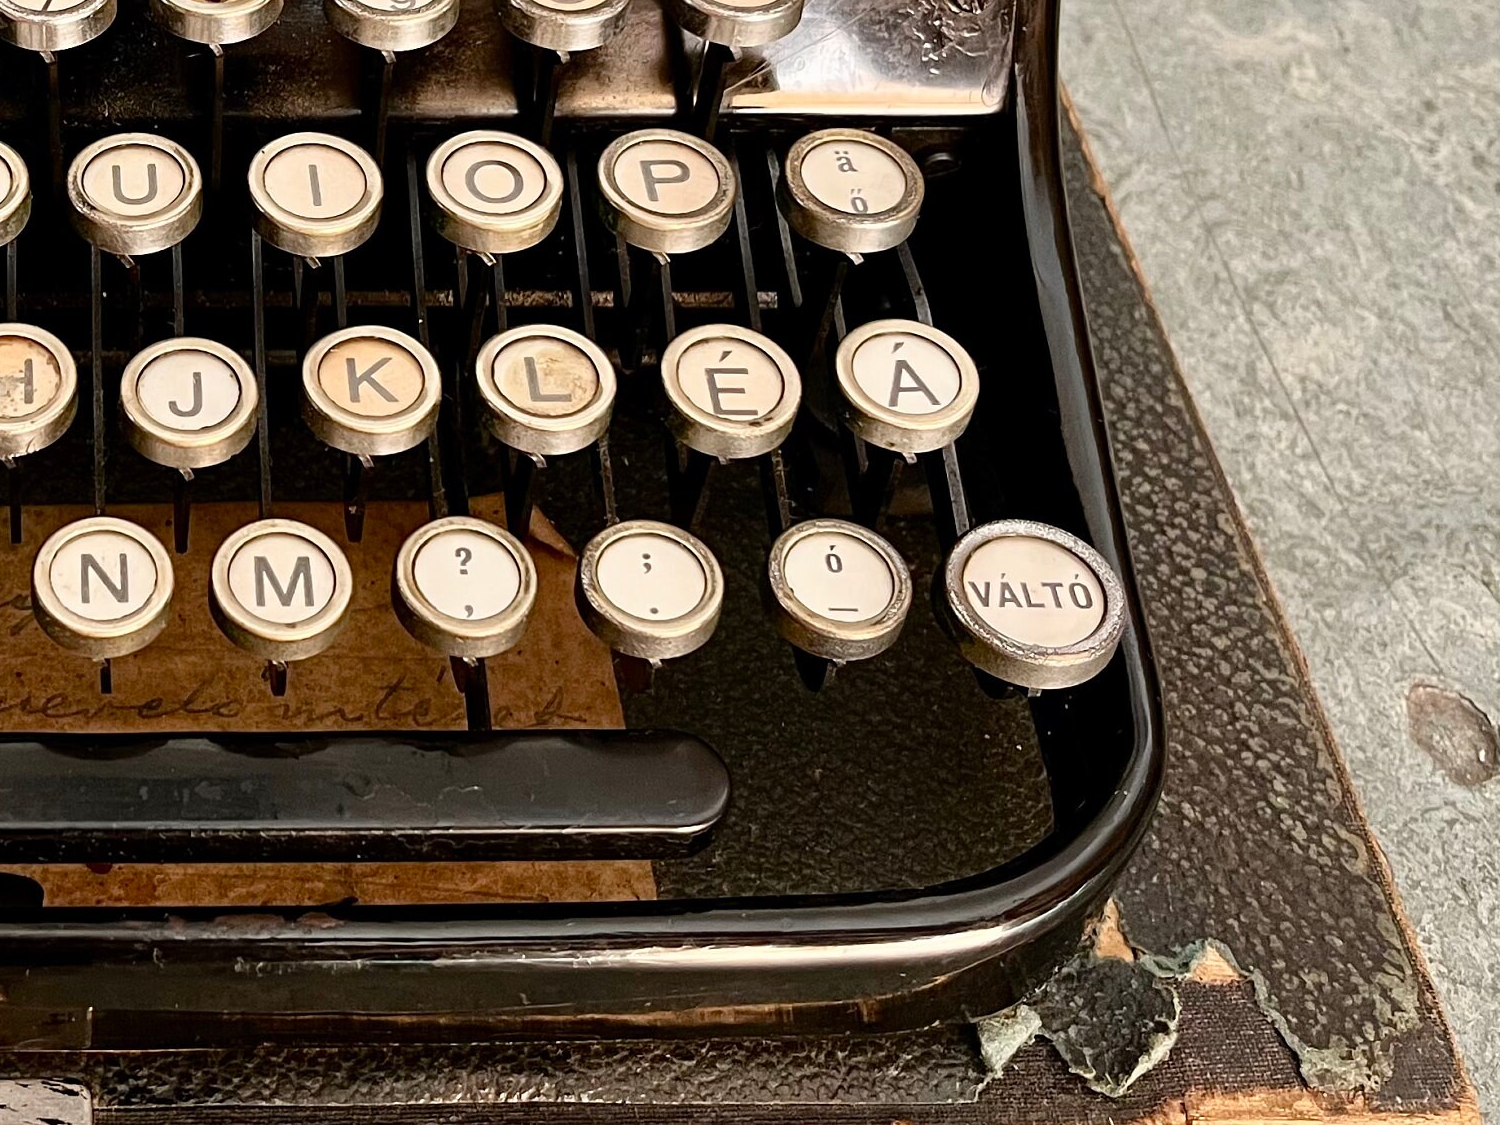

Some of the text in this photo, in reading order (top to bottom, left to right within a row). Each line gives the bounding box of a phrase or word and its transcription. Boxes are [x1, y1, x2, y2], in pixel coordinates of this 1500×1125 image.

[111, 163, 158, 204] U
[308, 164, 322, 207] I
[464, 159, 523, 204] O
[640, 159, 690, 202] P
[168, 372, 202, 417] J
[345, 356, 395, 403] K
[524, 356, 572, 403] L
[705, 349, 759, 416] É
[888, 341, 941, 407] Á
[79, 553, 129, 604] N
[254, 556, 315, 607] M
[454, 547, 472, 575] ?
[642, 553, 652, 574] ;
[967, 572, 1095, 610] VÁLTÓ
